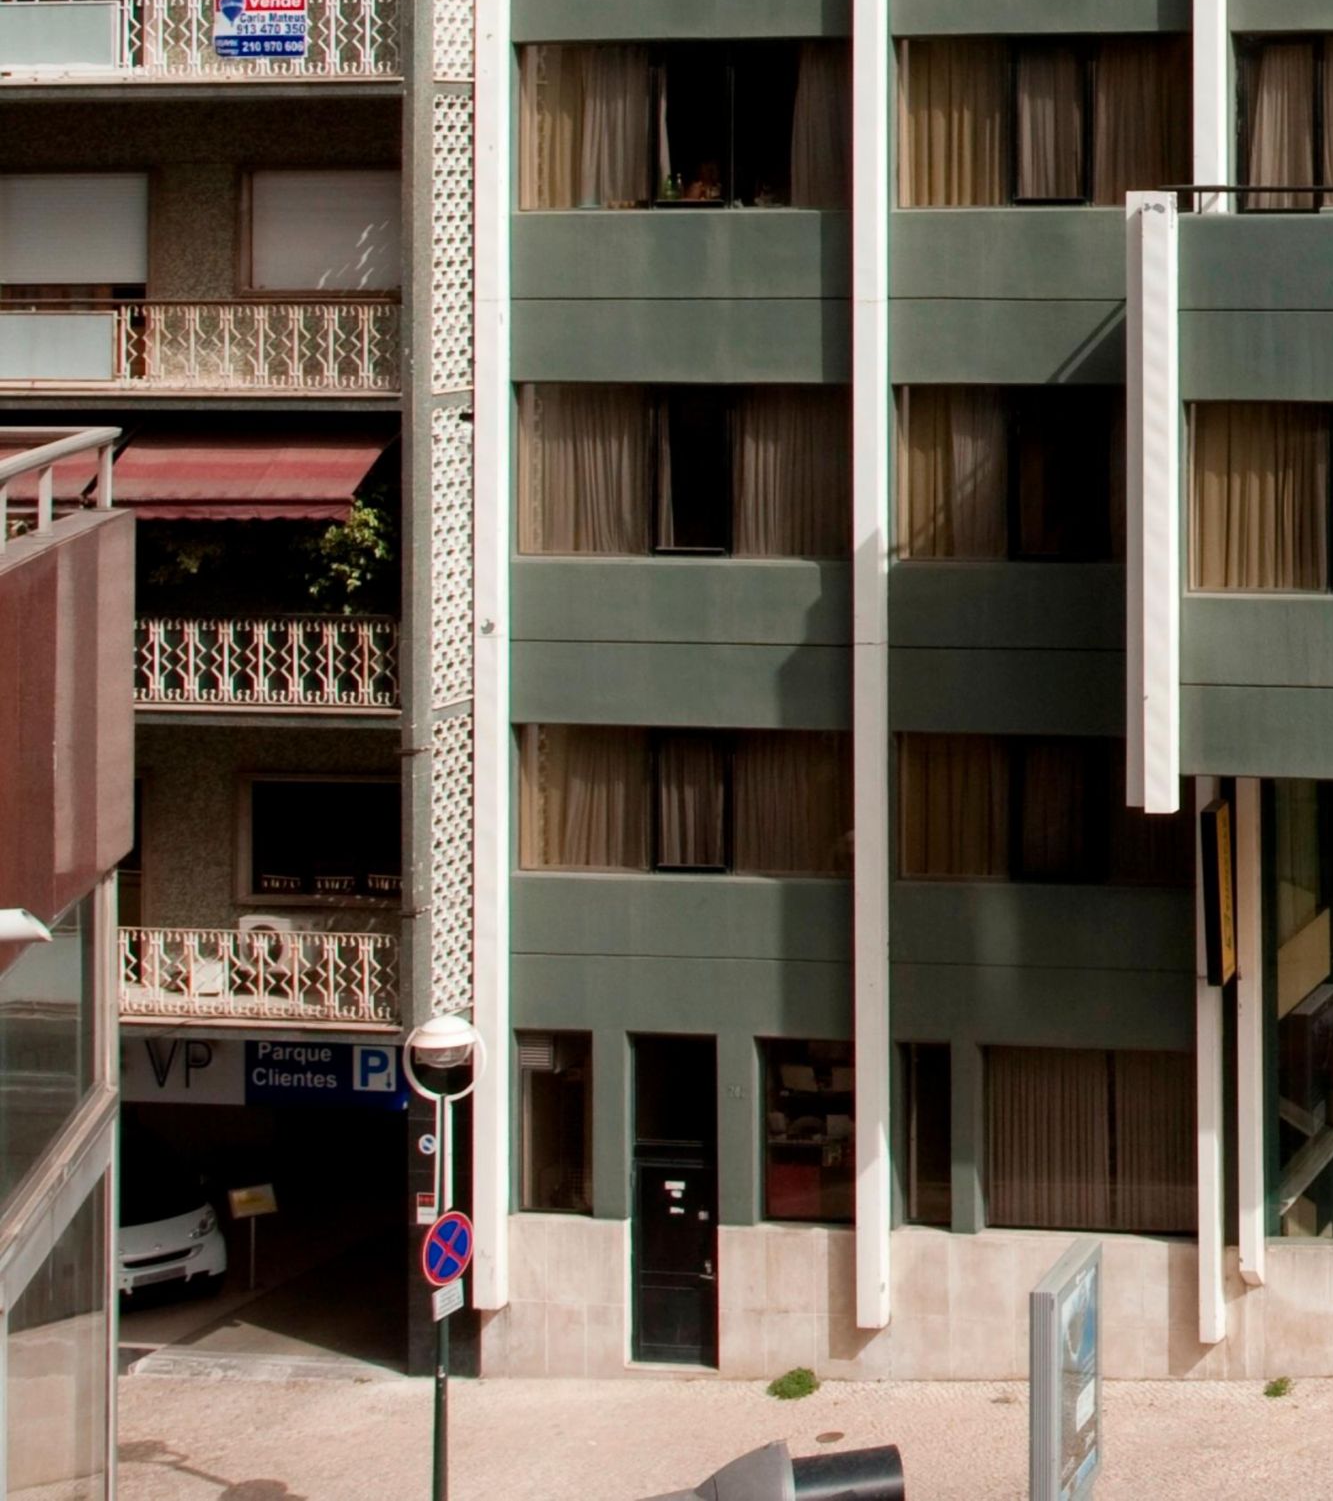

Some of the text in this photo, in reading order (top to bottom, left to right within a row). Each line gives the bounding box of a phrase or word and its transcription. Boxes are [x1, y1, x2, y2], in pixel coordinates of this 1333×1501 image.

[268, 12, 306, 23] Mateus
[242, 40, 261, 52] 210
[144, 1039, 213, 1089] VP
[257, 1042, 333, 1065] Parque
[251, 1068, 338, 1089] Clientes
[359, 1048, 390, 1088] P
